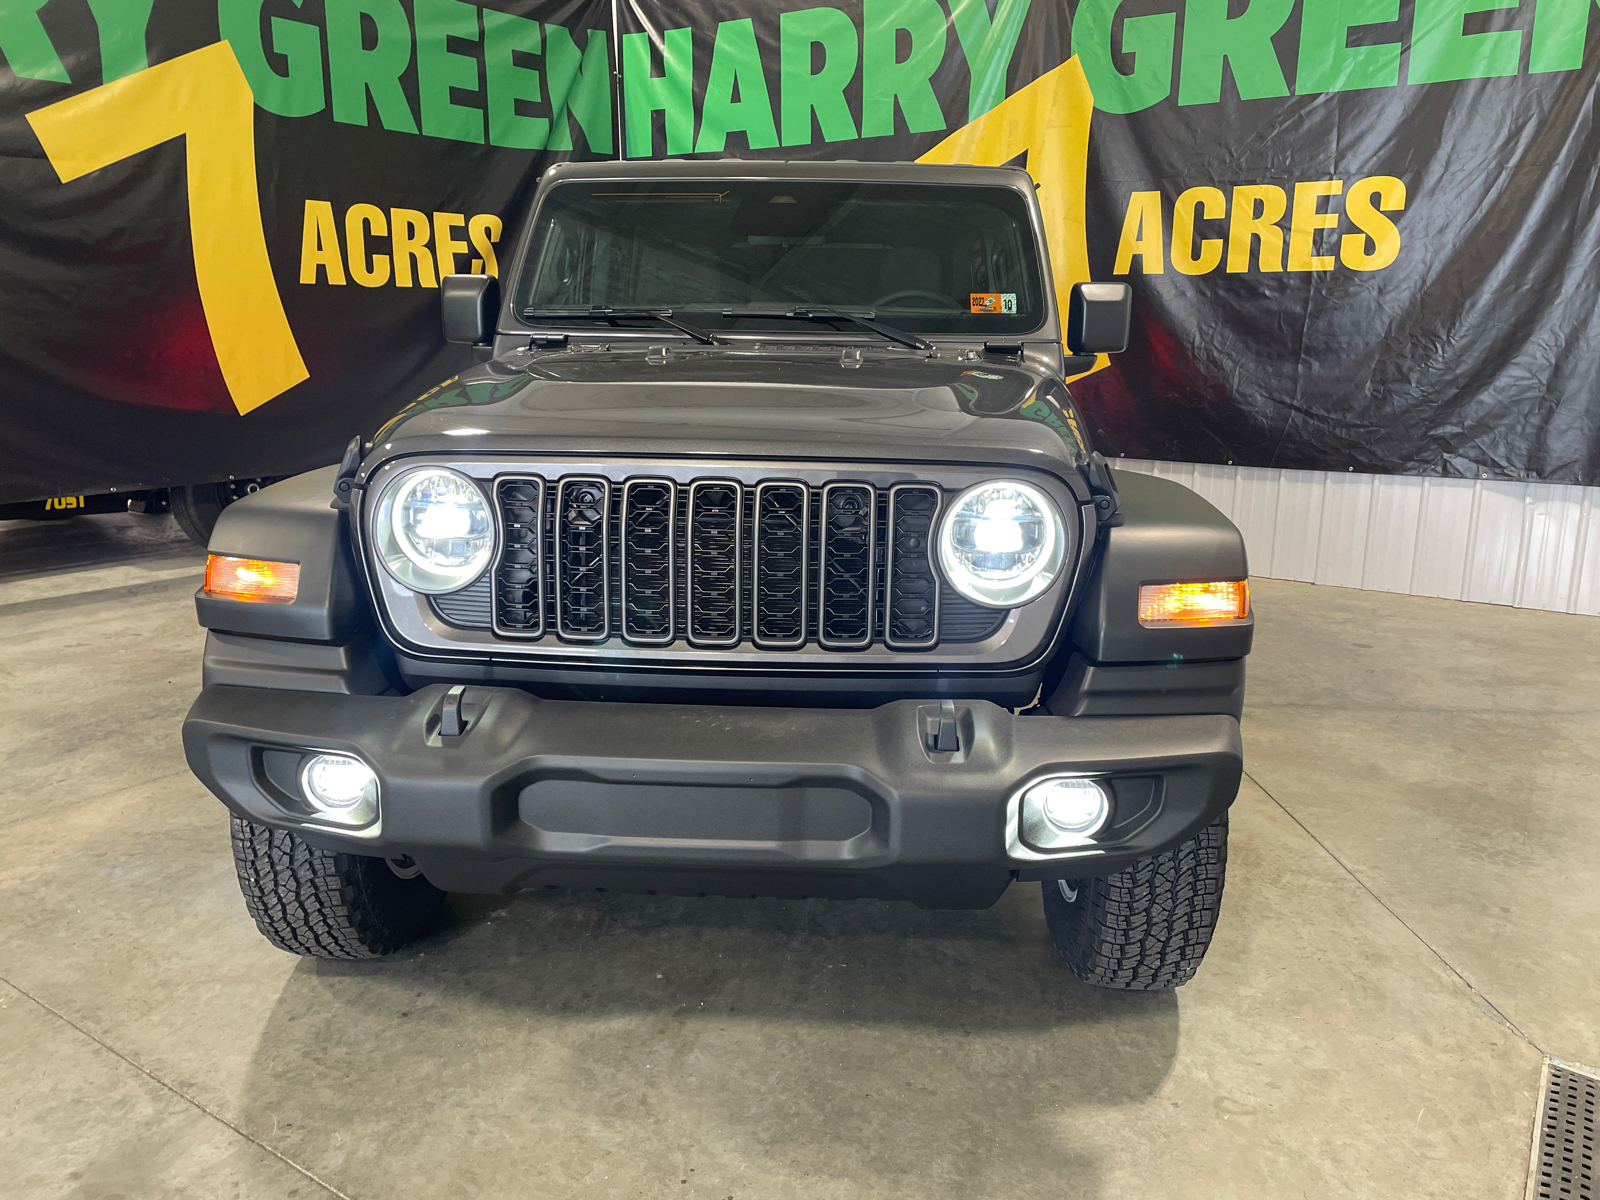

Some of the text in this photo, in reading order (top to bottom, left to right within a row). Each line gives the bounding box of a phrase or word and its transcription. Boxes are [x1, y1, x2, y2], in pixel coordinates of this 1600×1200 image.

[218, 0, 614, 154] GREEN
[622, 0, 1031, 158] HARRY
[25, 39, 503, 416] 7 ACRES
[1113, 176, 1406, 275] ACRES
